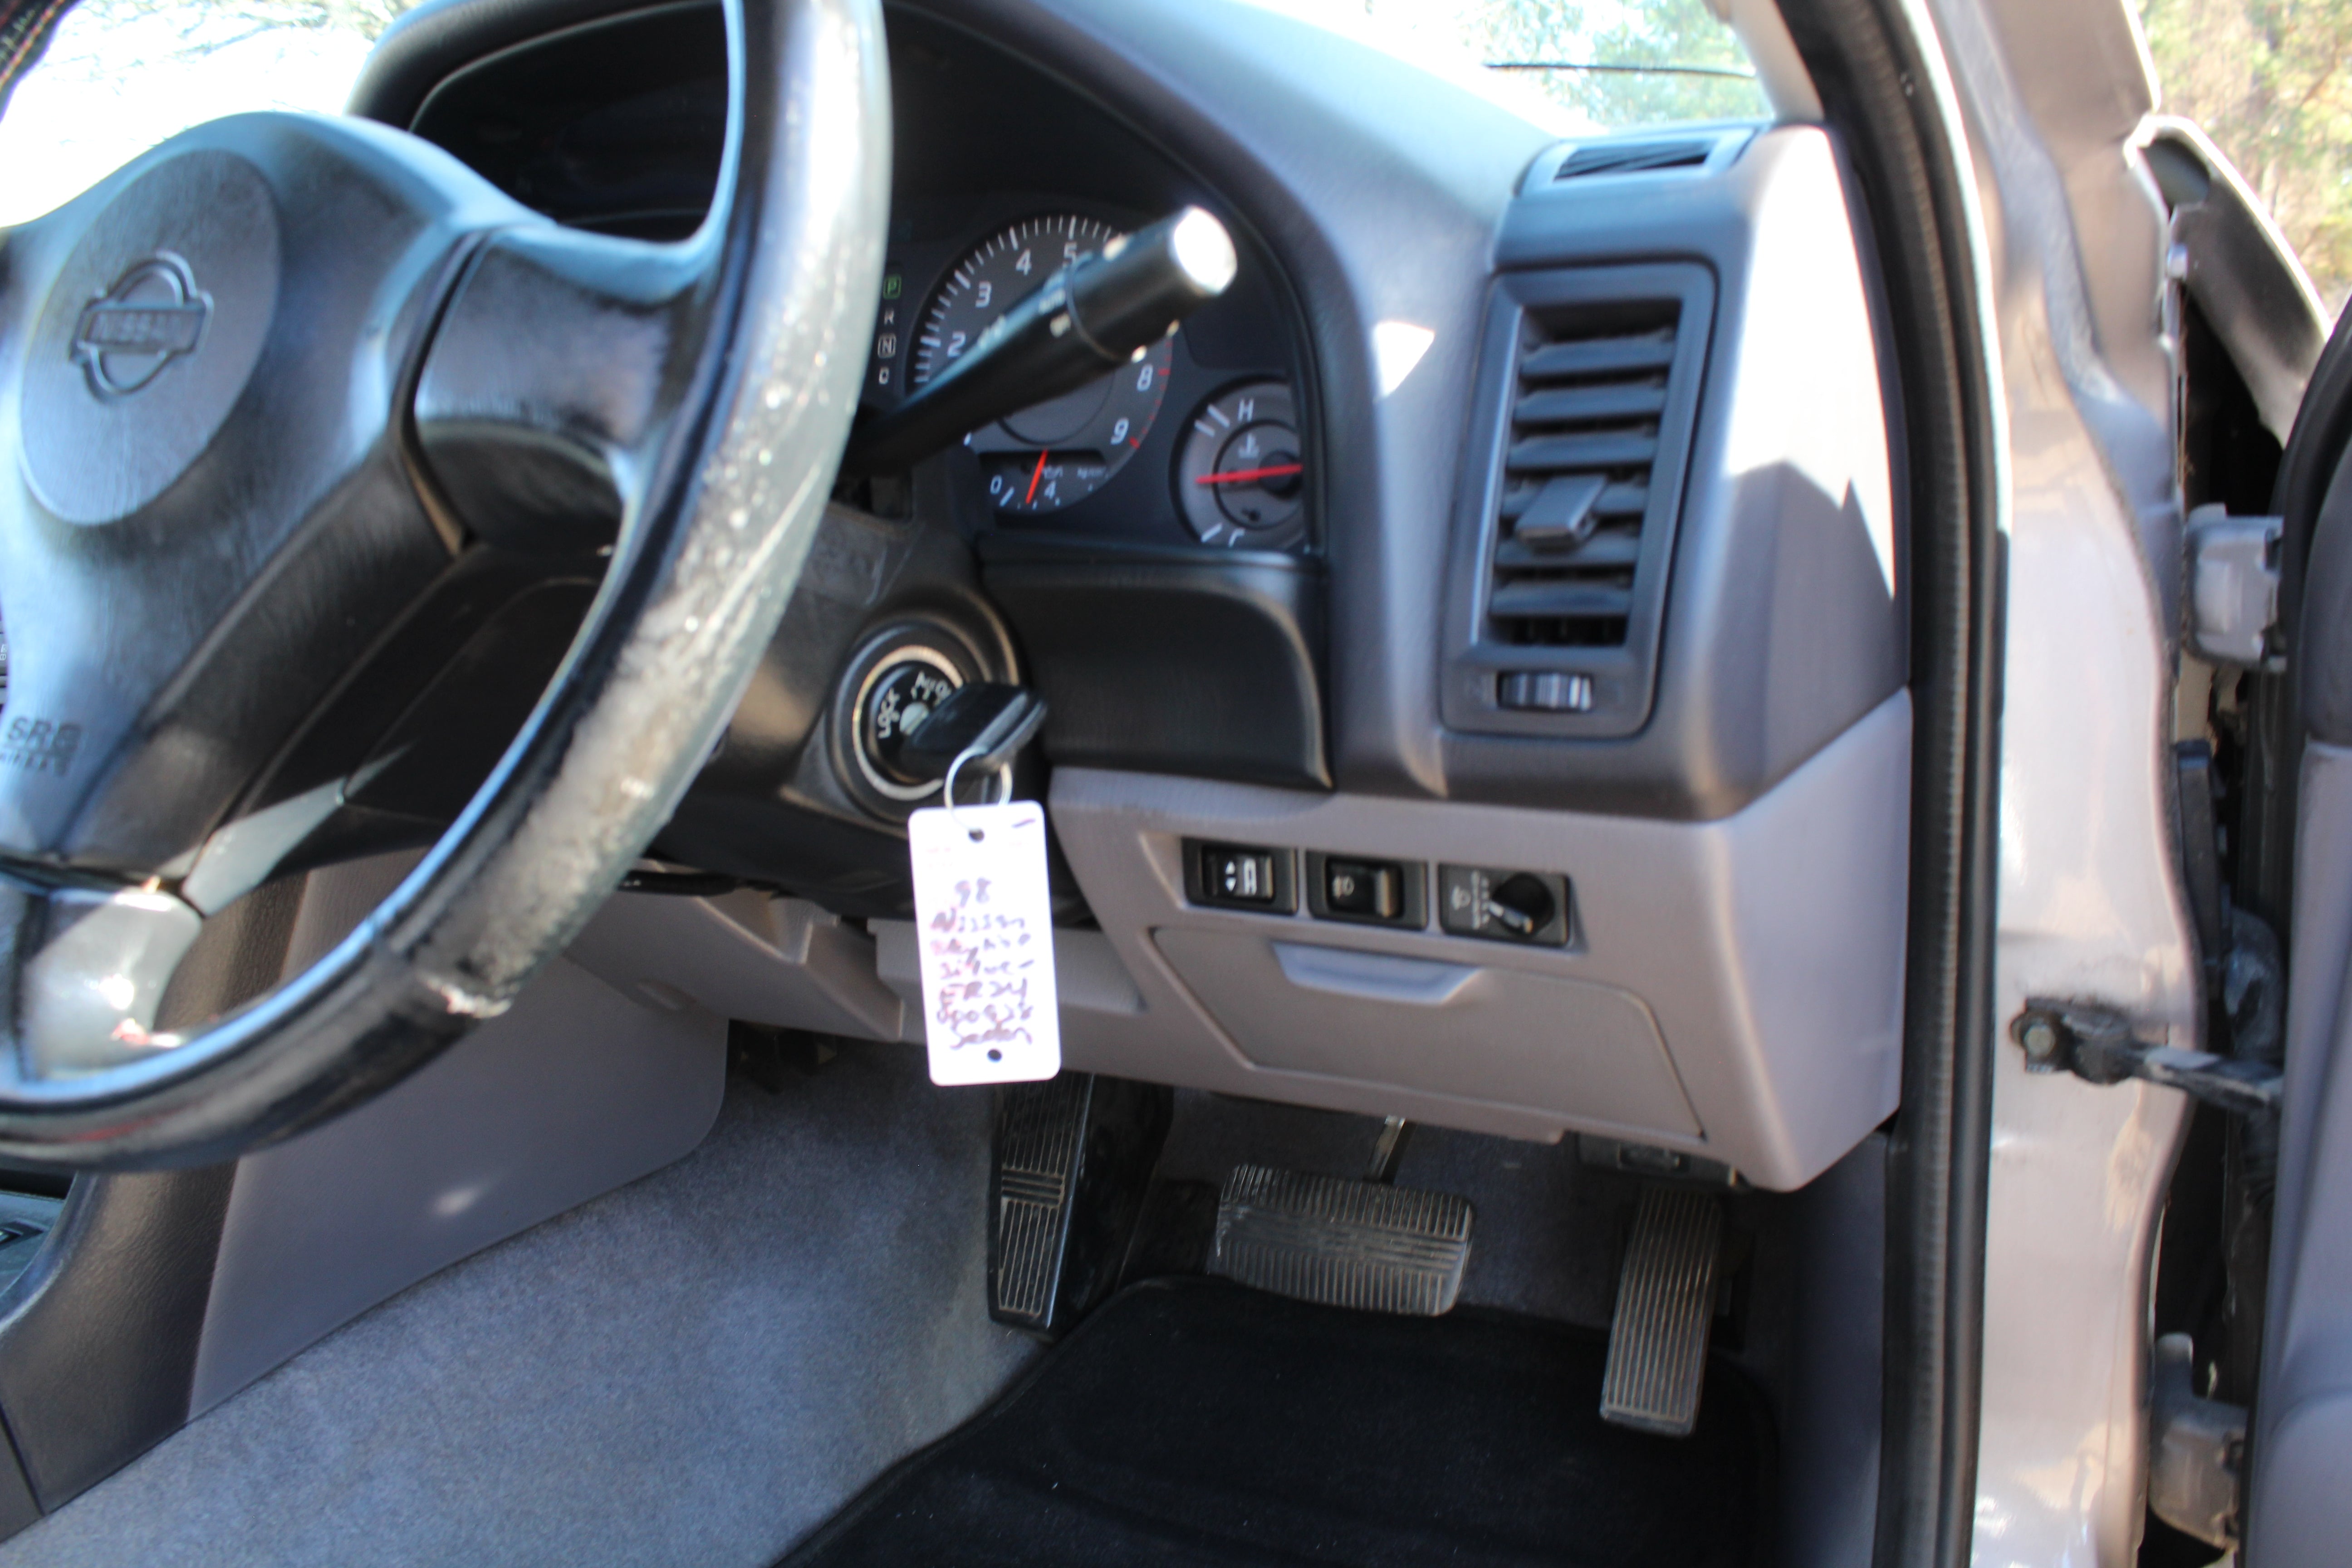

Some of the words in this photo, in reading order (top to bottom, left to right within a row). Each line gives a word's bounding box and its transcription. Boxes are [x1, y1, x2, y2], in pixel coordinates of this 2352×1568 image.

[1015, 248, 1032, 275] 4
[975, 280, 992, 308] 3
[947, 331, 966, 358] 2
[1137, 363, 1154, 392] 8
[1238, 398, 1254, 421] H
[1111, 416, 1130, 445] 9
[990, 475, 1002, 495] 0
[1044, 480, 1056, 499] 4
[877, 687, 901, 739] LOCK
